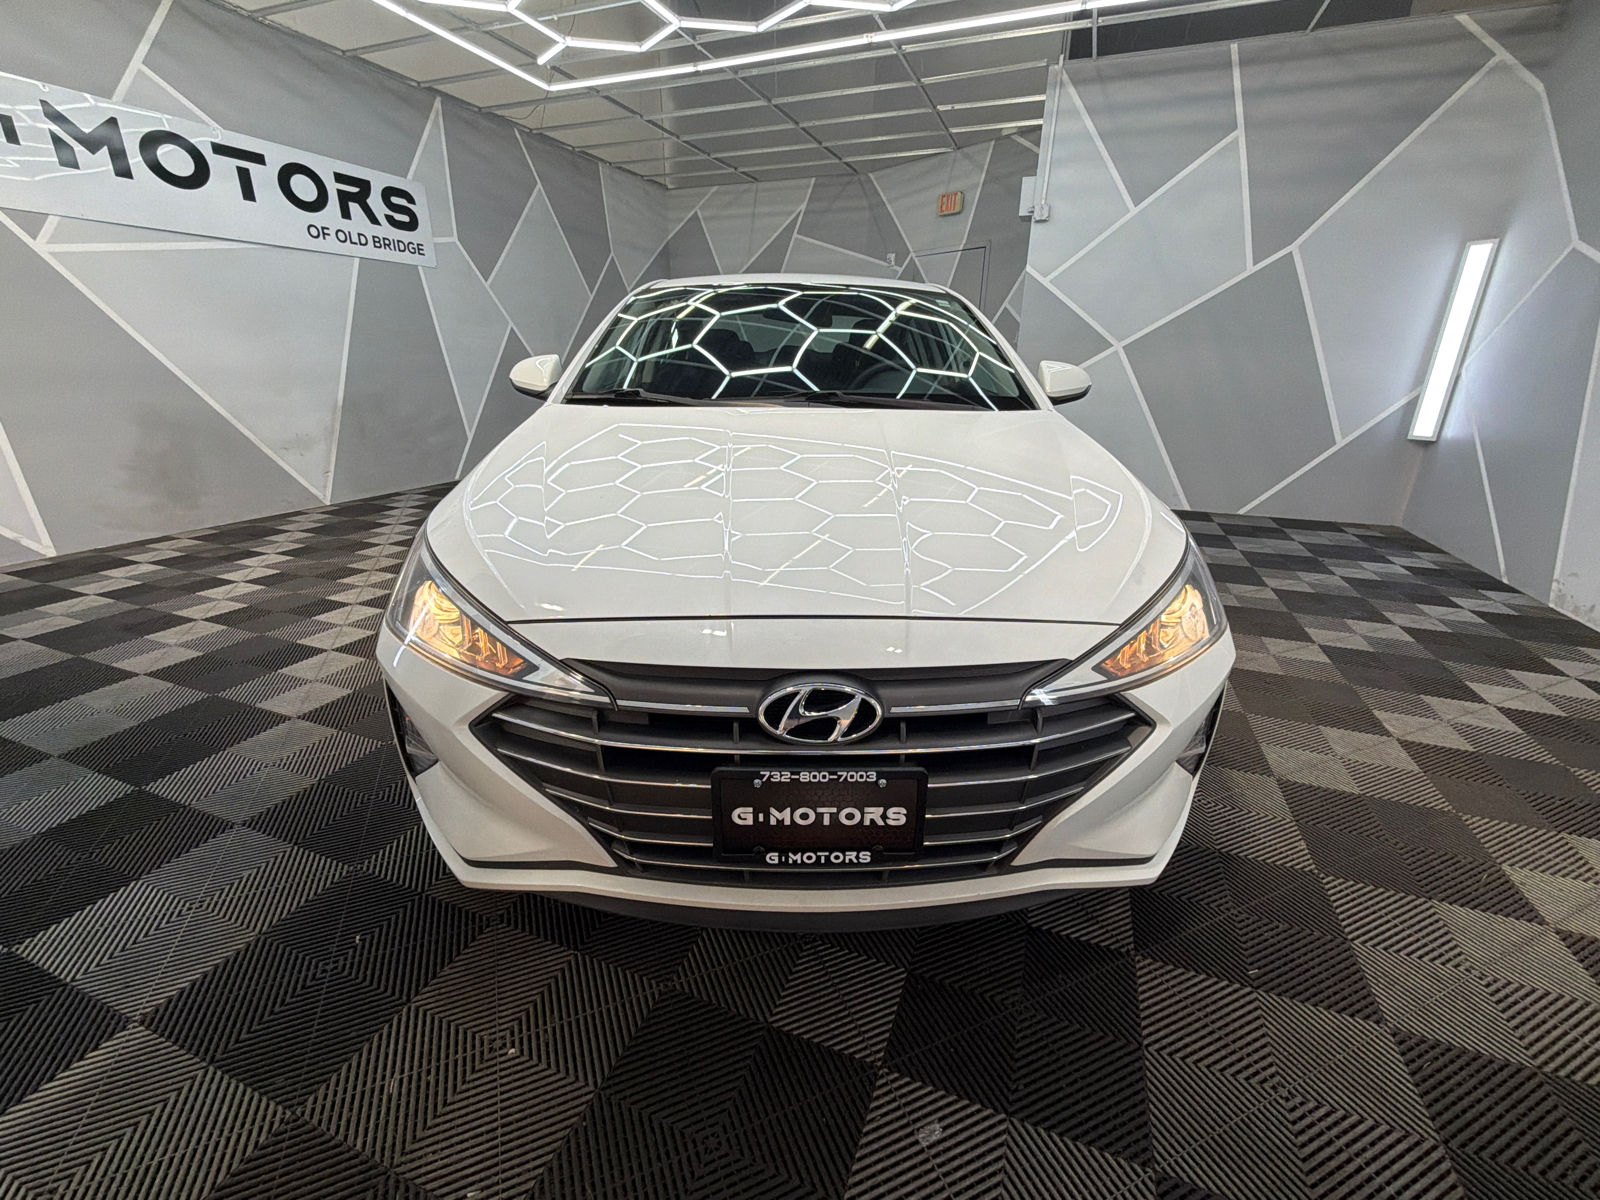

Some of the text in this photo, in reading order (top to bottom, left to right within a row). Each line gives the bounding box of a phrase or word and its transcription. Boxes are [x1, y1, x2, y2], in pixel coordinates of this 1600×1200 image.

[39, 99, 419, 232] MOTORS
[940, 192, 959, 214] EXIT
[307, 224, 426, 256] OF OLD BRIDGE
[760, 771, 877, 782] 732-800-7003
